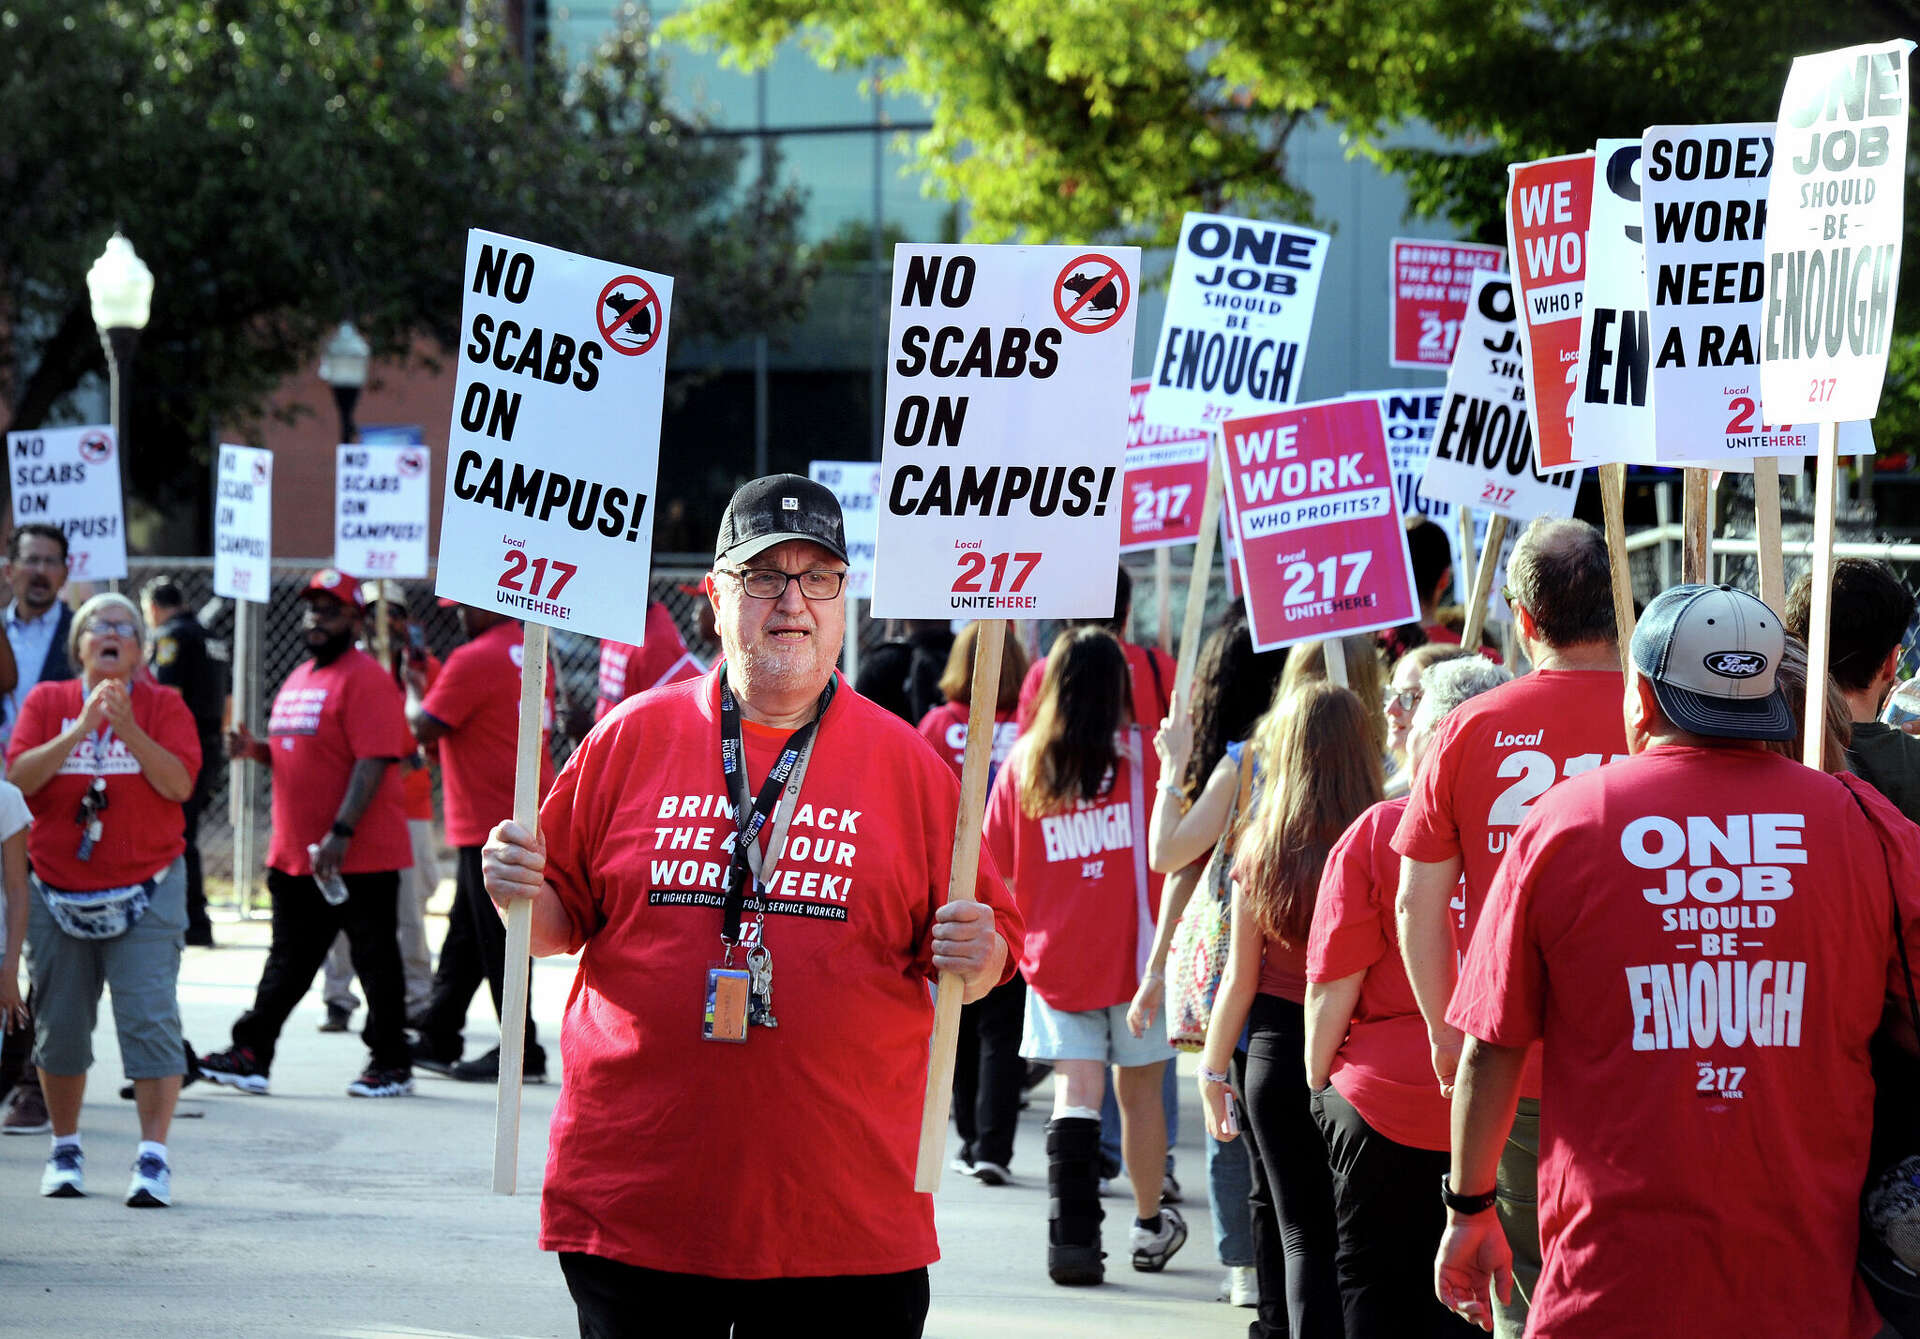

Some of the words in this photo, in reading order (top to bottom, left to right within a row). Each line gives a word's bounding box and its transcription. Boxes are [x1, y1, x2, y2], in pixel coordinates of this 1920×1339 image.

[1793, 126, 1889, 175] JOB
[1520, 181, 1572, 228] WE
[1800, 178, 1875, 209] SHOULD
[1823, 214, 1848, 241] BE
[1188, 222, 1317, 270] ONE
[472, 244, 535, 304] NO
[900, 255, 976, 308] NO
[1195, 266, 1298, 295] JOB
[1656, 262, 1764, 306] NEED
[1202, 292, 1282, 315] SHOULD
[1534, 292, 1569, 315] WHO
[1766, 244, 1895, 362] ENOUGH
[1226, 314, 1250, 330] BE
[1418, 319, 1463, 351] 21
[467, 313, 602, 392] SCABS
[896, 326, 1062, 379] SCABS
[1656, 326, 1686, 368] A
[1158, 327, 1299, 403] ENOUGH
[1724, 385, 1750, 396] Local
[1808, 378, 1837, 402] 217
[460, 381, 522, 442] ON
[894, 395, 969, 446] ON
[1384, 396, 1443, 420] NE
[15, 437, 44, 457] NO
[1235, 425, 1298, 466] WE
[1727, 435, 1806, 449] UNITEHERE!
[343, 452, 368, 467] NO
[17, 463, 85, 486] SCABS
[343, 475, 399, 492] SCABS
[1241, 453, 1375, 503] WORK.
[19, 493, 48, 514] ON
[454, 449, 647, 543] CAMPUS!
[889, 464, 1116, 517] CAMPUS!
[1132, 483, 1192, 522] 217
[1481, 484, 1516, 503] 217
[342, 500, 366, 515] ON
[1250, 512, 1290, 531] WHO
[1297, 496, 1381, 522] PROFITS?
[502, 534, 526, 549] Local
[955, 539, 982, 549] Local
[1277, 549, 1306, 565] Local
[498, 549, 578, 601] 217
[951, 552, 1043, 592] 217
[1283, 551, 1373, 607] 217
[496, 590, 571, 620] UNITEHERE!
[951, 596, 1036, 609] UNITEHERE!
[1285, 594, 1377, 622] UNITEHERE!
[1718, 653, 1760, 673] Ford
[1494, 729, 1544, 747] Local
[657, 794, 735, 820] BRIN
[654, 827, 714, 851] THE
[1041, 802, 1133, 862] ENOUGH
[1620, 813, 1807, 869] ONE
[1082, 861, 1104, 879] 217
[1643, 866, 1794, 905] JOB
[650, 893, 659, 903] CT
[662, 893, 692, 904] HIGHER
[694, 893, 726, 906] EDUCAT
[768, 902, 803, 914] SERVICE
[806, 905, 846, 919] WORKERS
[1663, 905, 1776, 931] SHOULD
[739, 922, 759, 941] 17
[1701, 933, 1738, 956] BE
[1625, 960, 1807, 1050] ENOUGH
[1696, 1066, 1747, 1091] 217
